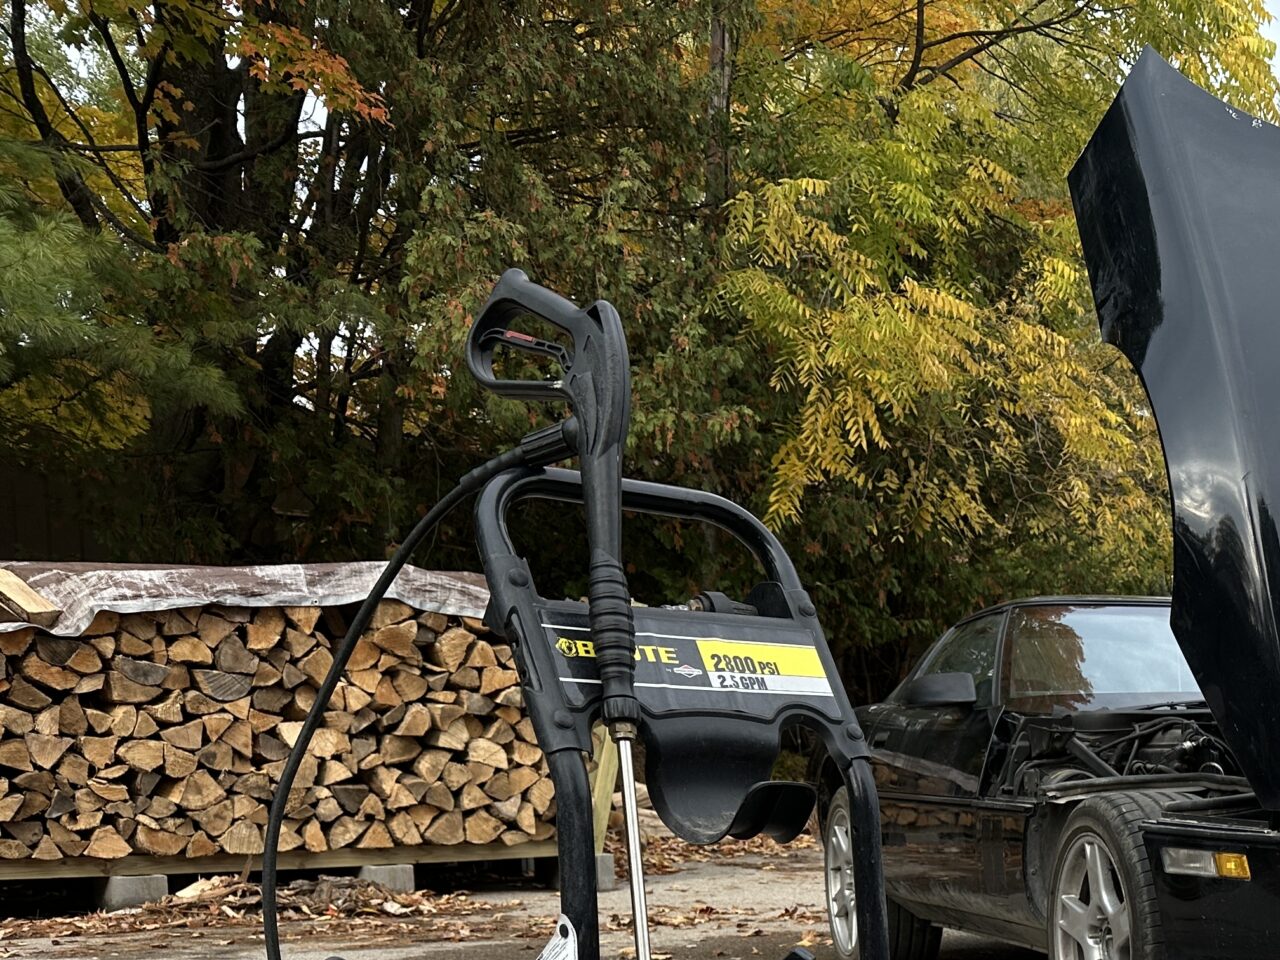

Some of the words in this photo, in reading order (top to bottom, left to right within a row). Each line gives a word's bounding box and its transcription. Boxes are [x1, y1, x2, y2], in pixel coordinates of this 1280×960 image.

[710, 654, 757, 674] 2800
[757, 661, 780, 675] PSI
[717, 675, 739, 688] 2.5
[740, 676, 768, 690] GPM
